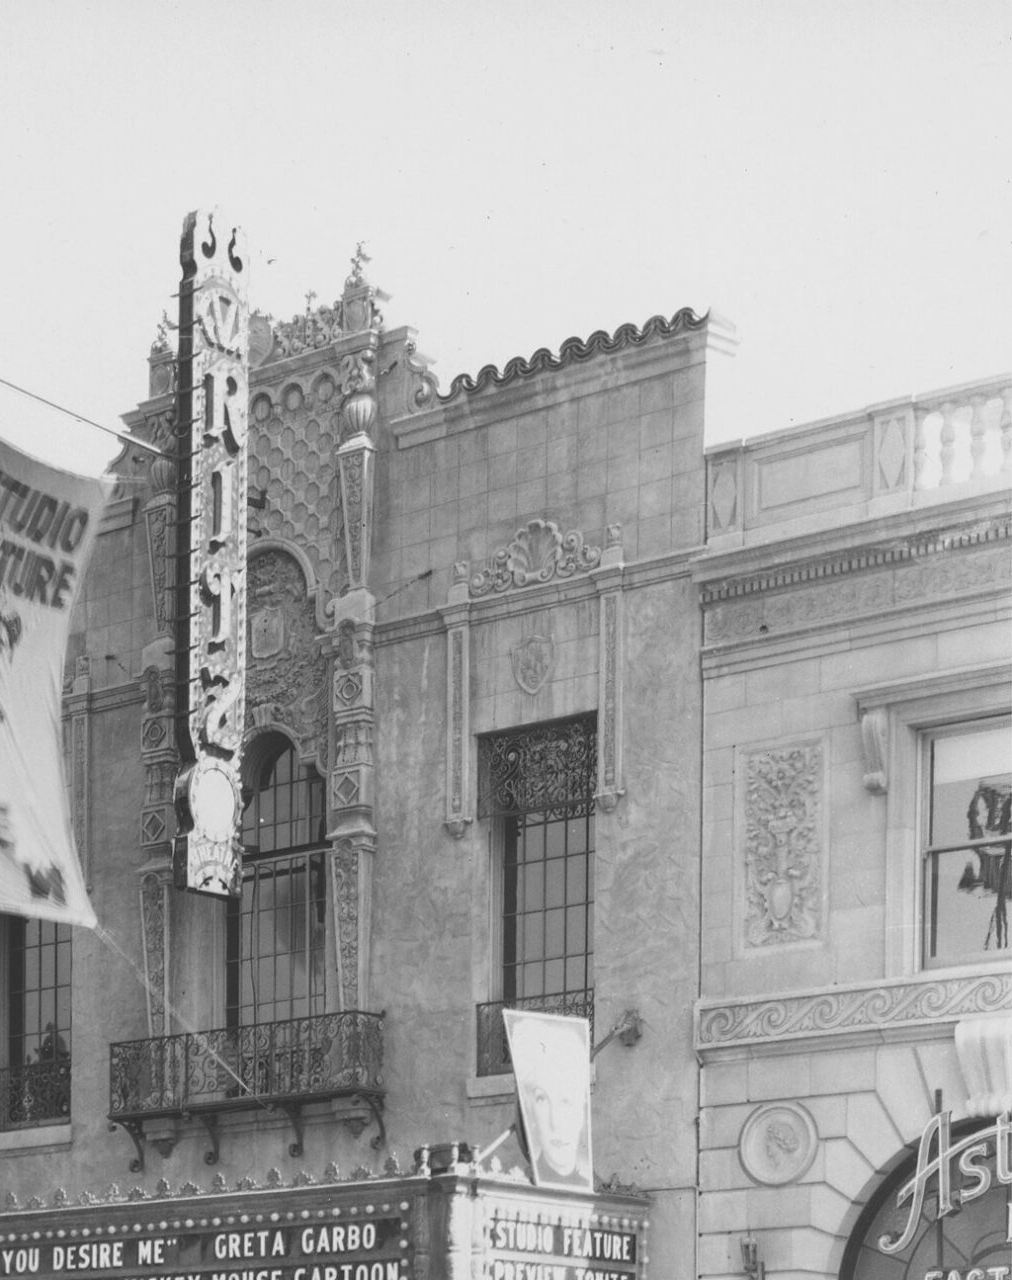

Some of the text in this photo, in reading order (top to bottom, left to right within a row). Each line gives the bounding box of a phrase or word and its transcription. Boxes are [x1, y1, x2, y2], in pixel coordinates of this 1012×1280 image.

[2, 1248, 39, 1274] YOU
[52, 1242, 124, 1271] DESIRE
[215, 1230, 285, 1259] GRETA
[301, 1223, 376, 1254] GARBO
[495, 1220, 631, 1260] STUDIO FEATURE
